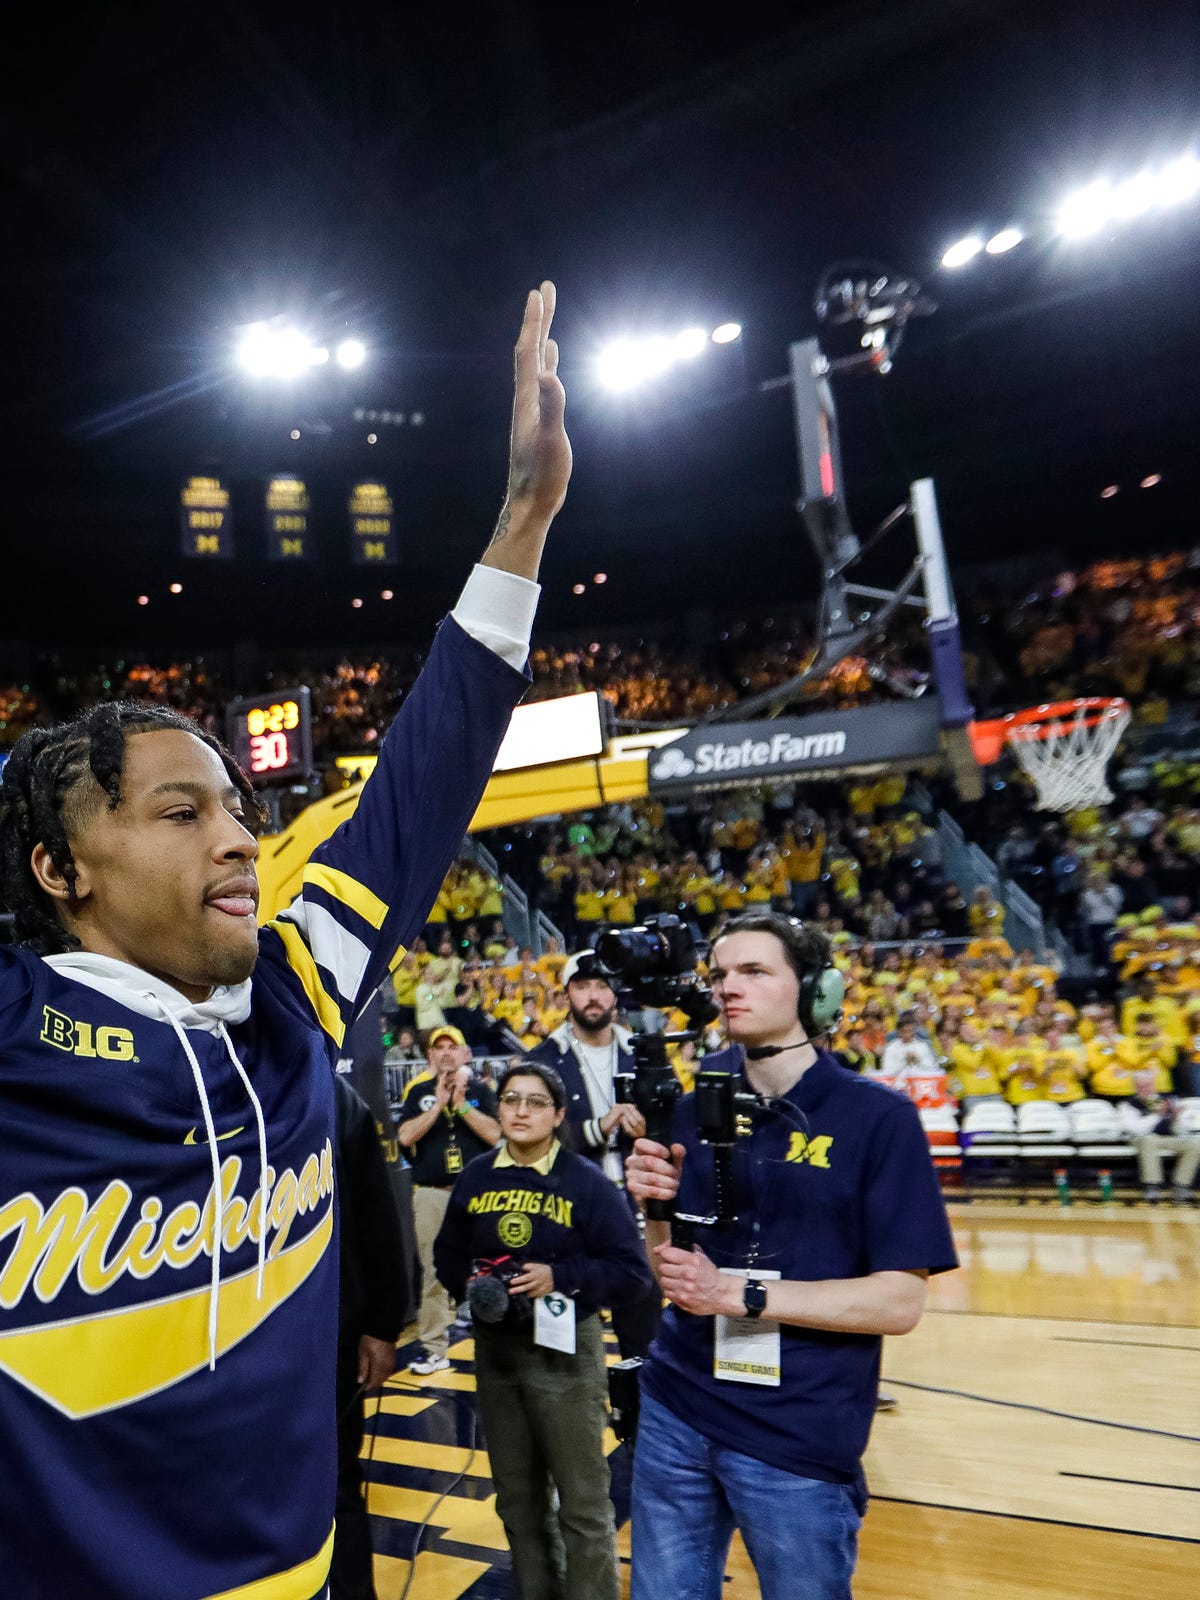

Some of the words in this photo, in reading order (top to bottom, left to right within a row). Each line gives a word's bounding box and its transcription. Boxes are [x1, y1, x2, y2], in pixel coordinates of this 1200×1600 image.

[250, 732, 288, 772] 30
[784, 1131, 834, 1169] M
[467, 1189, 574, 1228] MICHIGAN
[719, 1361, 750, 1373] SINGLE
[750, 1365, 779, 1377] GAME
